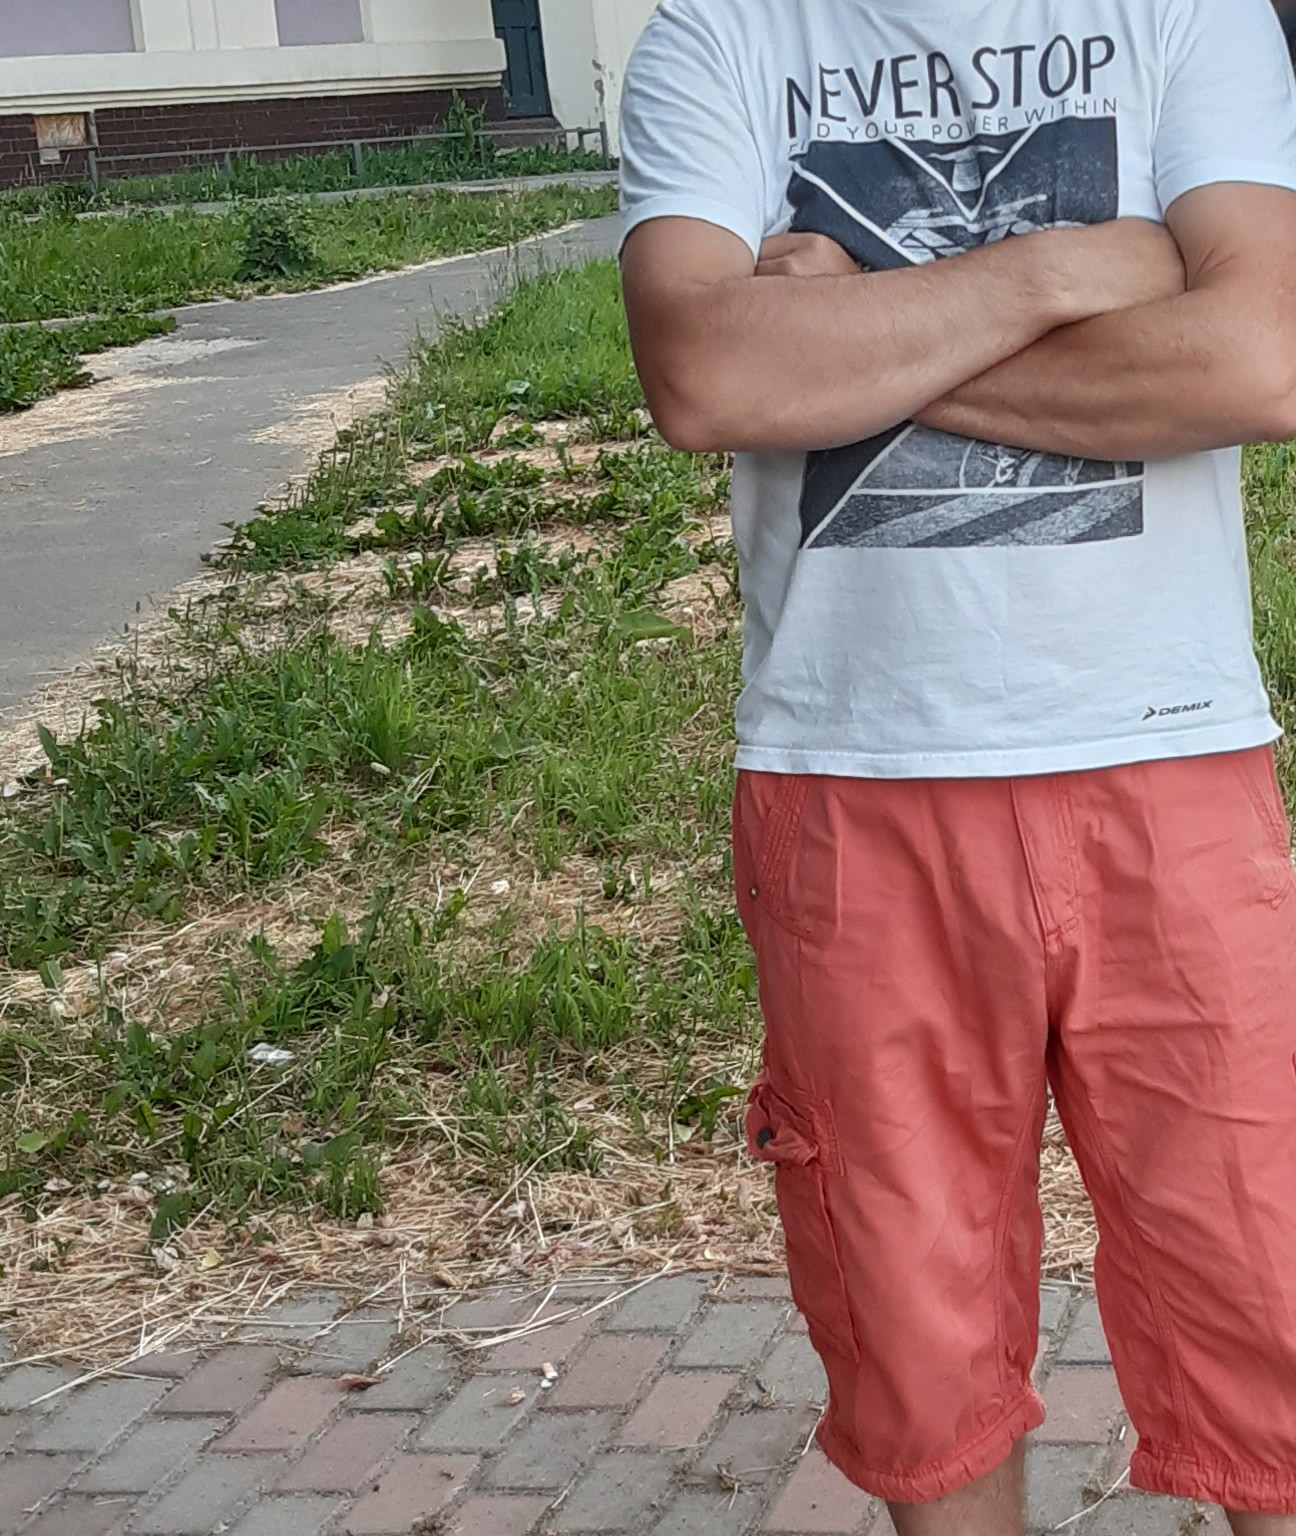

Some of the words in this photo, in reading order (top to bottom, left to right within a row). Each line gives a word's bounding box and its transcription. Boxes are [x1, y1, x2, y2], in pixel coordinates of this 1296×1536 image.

[785, 51, 962, 139] NEVER
[971, 33, 1116, 110] STOP
[787, 122, 831, 155] FID
[849, 120, 916, 140] YOUR
[931, 115, 1009, 140] POWER
[1023, 97, 1117, 124] WITHIN
[1158, 699, 1213, 716] DEMIX
